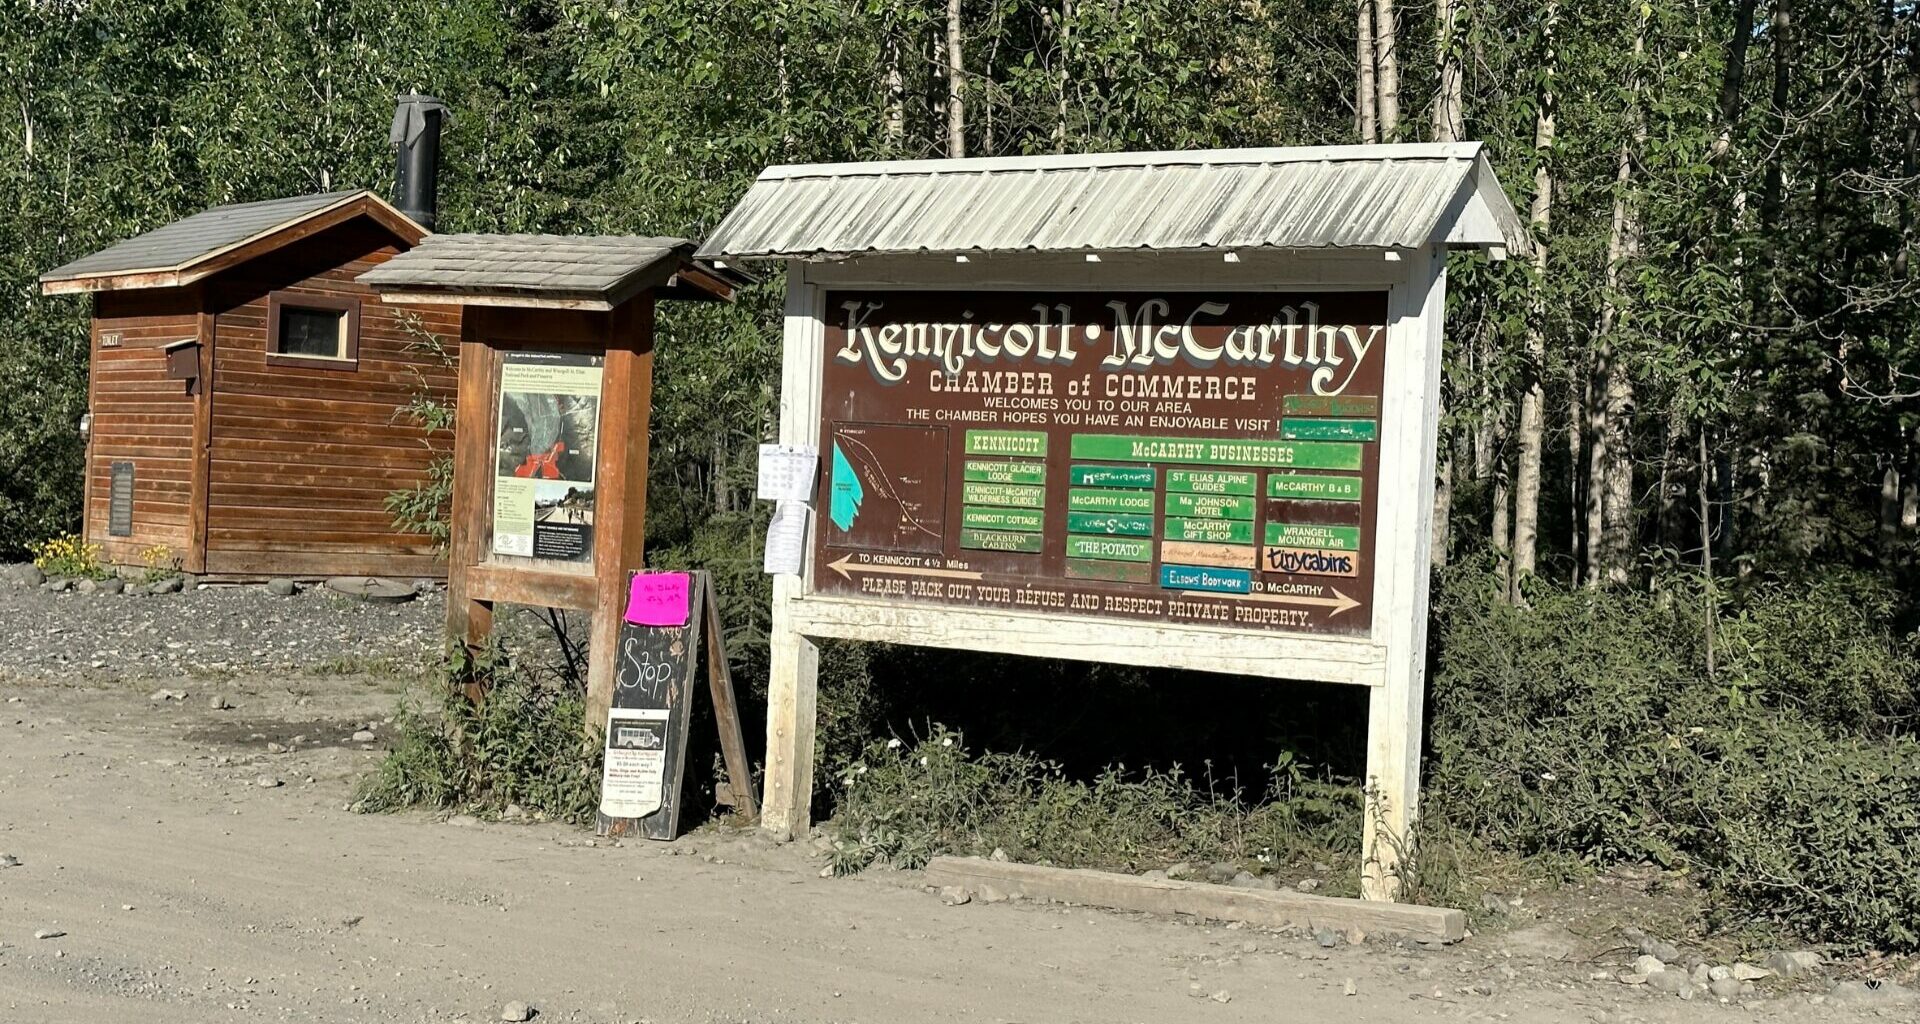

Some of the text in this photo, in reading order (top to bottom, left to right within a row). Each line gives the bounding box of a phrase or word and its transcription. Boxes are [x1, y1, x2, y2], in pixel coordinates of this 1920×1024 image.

[836, 298, 1384, 397] Kennicott McCarthy
[929, 370, 1257, 400] CHAMBER of COMMERCE
[983, 396, 1192, 414] WELCOMES YOU TO OUR AREA
[906, 408, 930, 421] THE
[935, 409, 998, 422] CHAMBER
[1002, 410, 1048, 424] HOPES
[1053, 412, 1080, 425] YOU
[1084, 414, 1119, 427] HAVE
[1124, 414, 1144, 428] AN
[1150, 416, 1229, 431] ENJOYABLE
[1234, 418, 1271, 432] VISIT
[973, 436, 1040, 452] KENNICOTT
[1132, 441, 1294, 463] McCARTHY BUSINESSES
[967, 462, 1042, 474] KENNICOTT GLACIER
[988, 472, 1013, 480] LODGE
[1172, 474, 1248, 484] ST. ELIAS ALPINE
[966, 486, 1042, 498] KENNICOTT-McCARTHY
[1192, 482, 1226, 492] GUIDES
[1275, 482, 1326, 492] McCARTHY
[1328, 483, 1336, 493] B
[1344, 484, 1351, 494] B
[968, 494, 1037, 506] WILDERNESS GUIDES
[1072, 496, 1150, 507] McCARTHY LODGE
[1179, 497, 1239, 508] Ma JOHNSON
[1194, 506, 1222, 516] HOTEL
[966, 514, 1038, 526] KENNICOTT COTTAGE
[1184, 522, 1232, 531] McCARTHY
[1283, 527, 1334, 538] WRANGELL
[974, 532, 1026, 544] BLACKBURN
[1184, 531, 1232, 540] GIFT SHOP
[1278, 534, 1344, 548] MOUNTAIN AIR
[982, 541, 1016, 550] CABINS
[858, 553, 870, 563] TO
[872, 554, 922, 566] KENNICOTT
[924, 558, 930, 567] 4
[946, 559, 969, 570] Miles
[1266, 548, 1353, 573] tinycabins
[1250, 580, 1324, 596] TO McCARTHY
[862, 577, 1314, 628] PLEASE PACK OUT YOUR REFUSE AND RESPECT PRIVATE PROPERTY.
[620, 637, 672, 700] Stop
